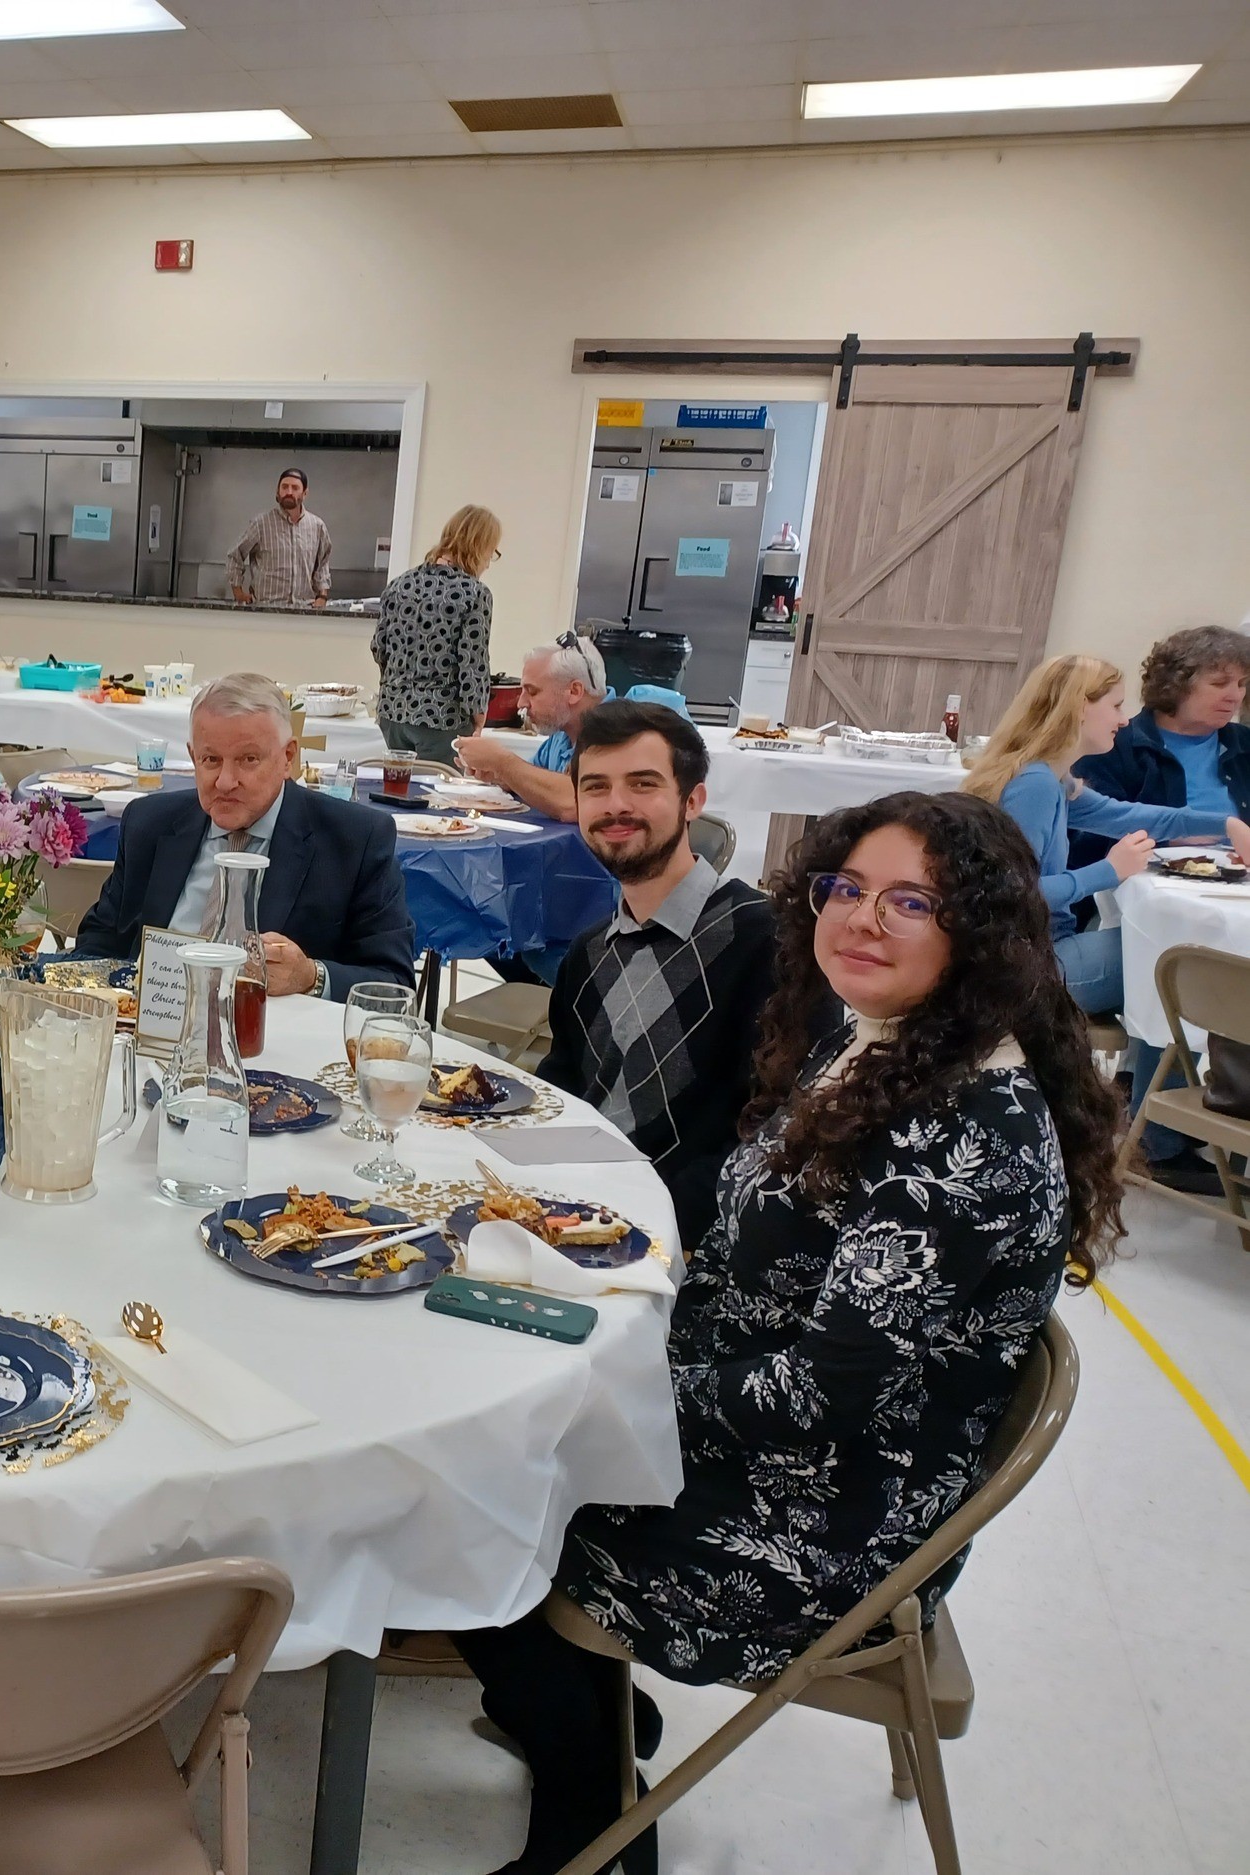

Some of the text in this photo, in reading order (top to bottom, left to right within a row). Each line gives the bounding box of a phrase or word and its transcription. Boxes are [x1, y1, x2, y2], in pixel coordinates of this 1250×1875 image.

[151, 961, 158, 969] I
[173, 966, 183, 974] do
[147, 976, 187, 991] things thro
[151, 992, 176, 1005] Christ
